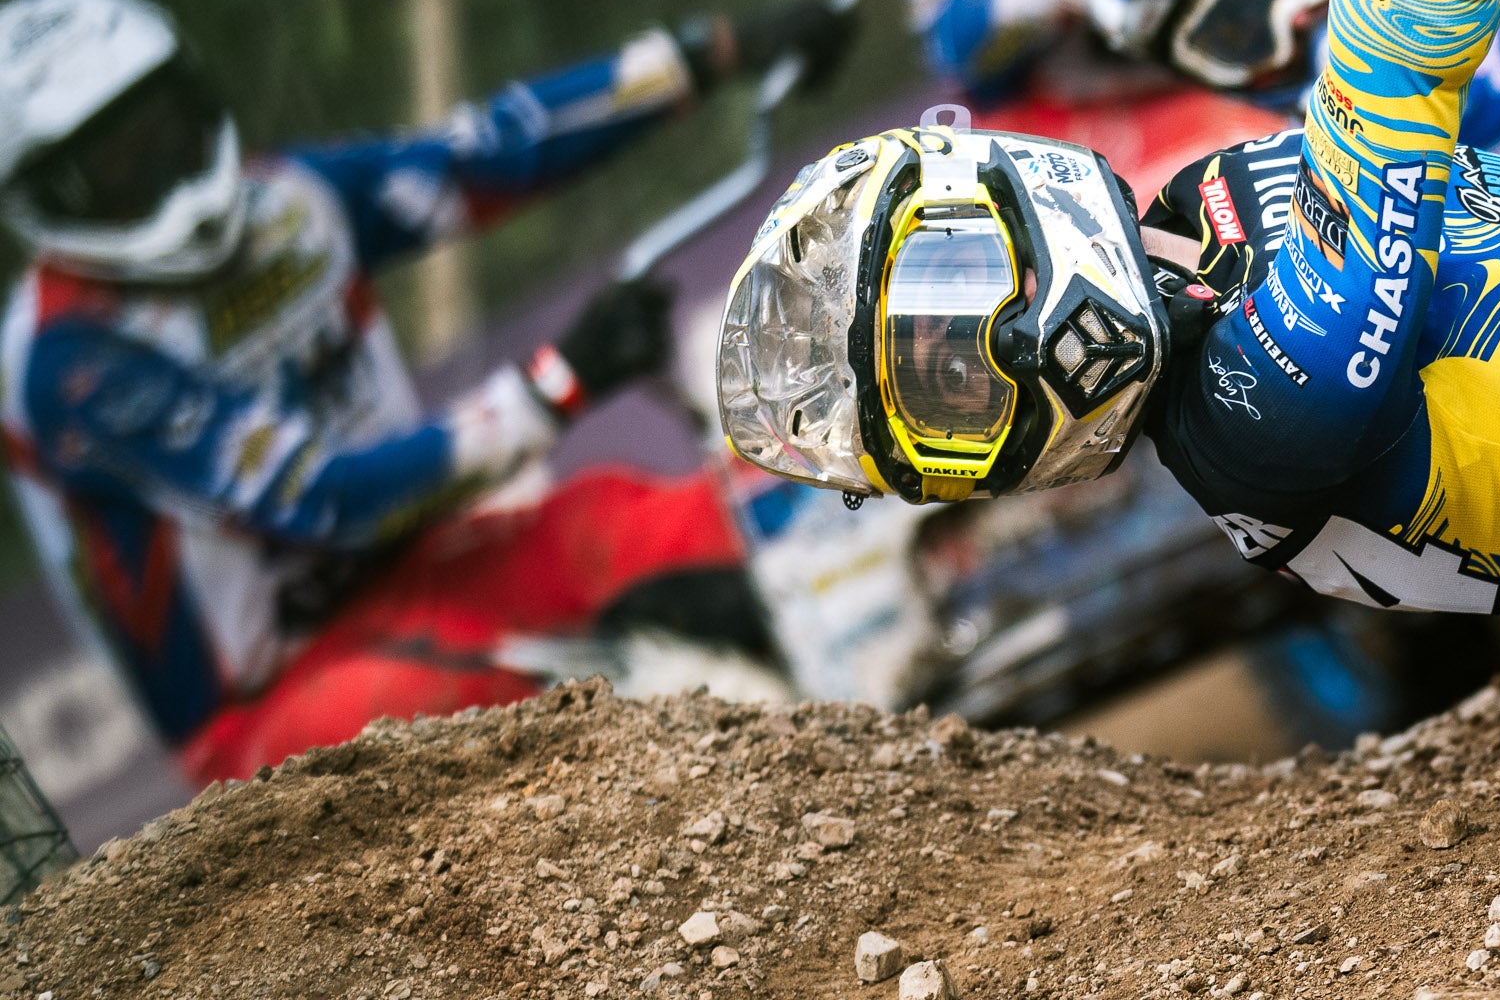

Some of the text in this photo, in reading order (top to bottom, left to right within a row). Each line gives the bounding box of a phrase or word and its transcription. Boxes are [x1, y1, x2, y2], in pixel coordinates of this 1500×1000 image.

[1203, 180, 1242, 240] MOTUL
[1347, 163, 1424, 388] CHASTA
[922, 466, 980, 479] OAKLEY
